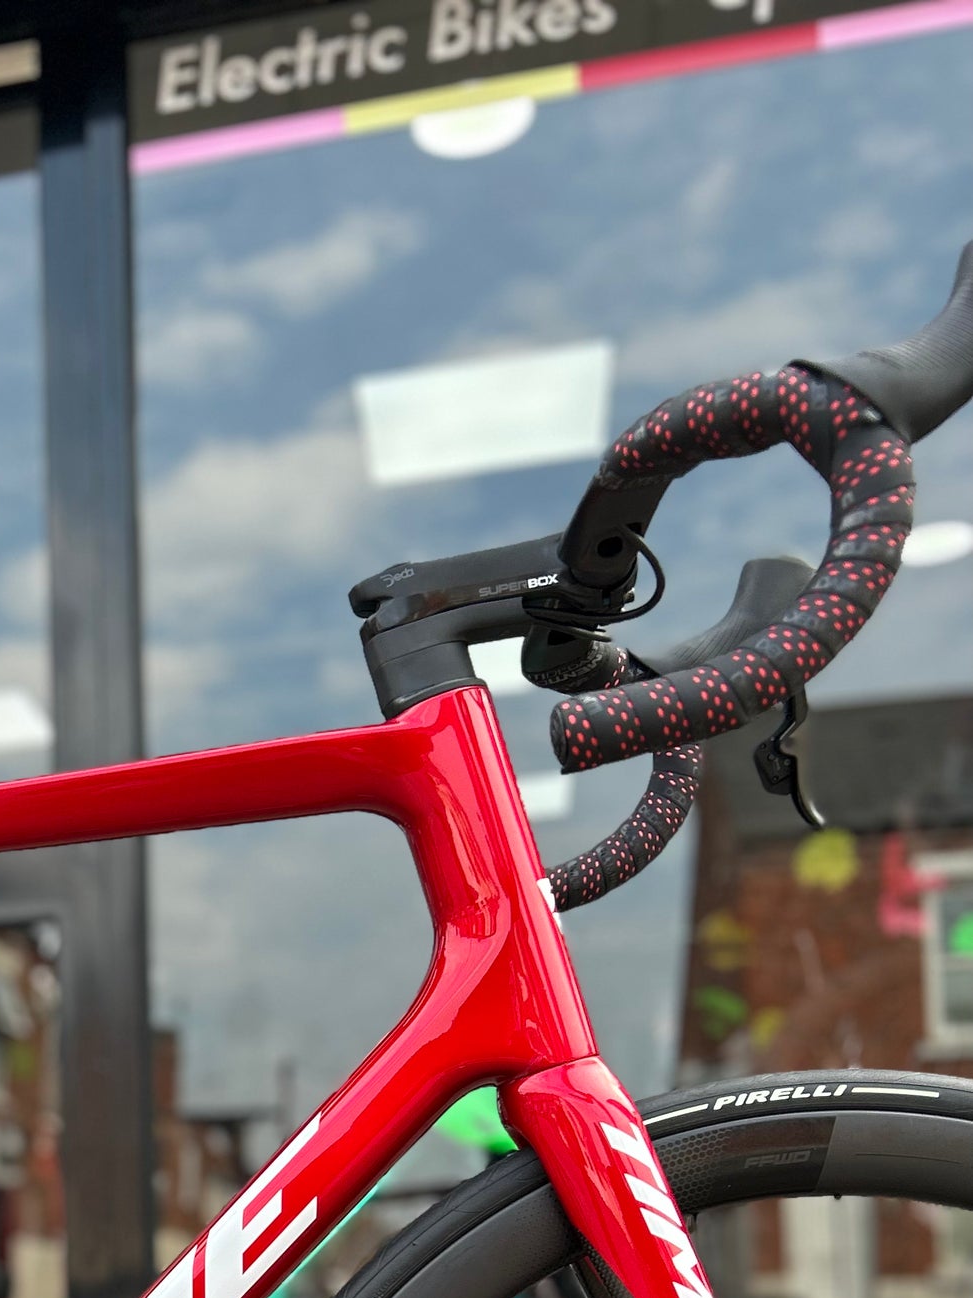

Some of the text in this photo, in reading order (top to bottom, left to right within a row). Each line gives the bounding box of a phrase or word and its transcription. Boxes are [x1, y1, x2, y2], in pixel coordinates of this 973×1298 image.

[157, 0, 617, 114] Electric Bikes
[478, 573, 559, 597] SUPERBOX
[713, 1084, 848, 1111] PIRELLI
